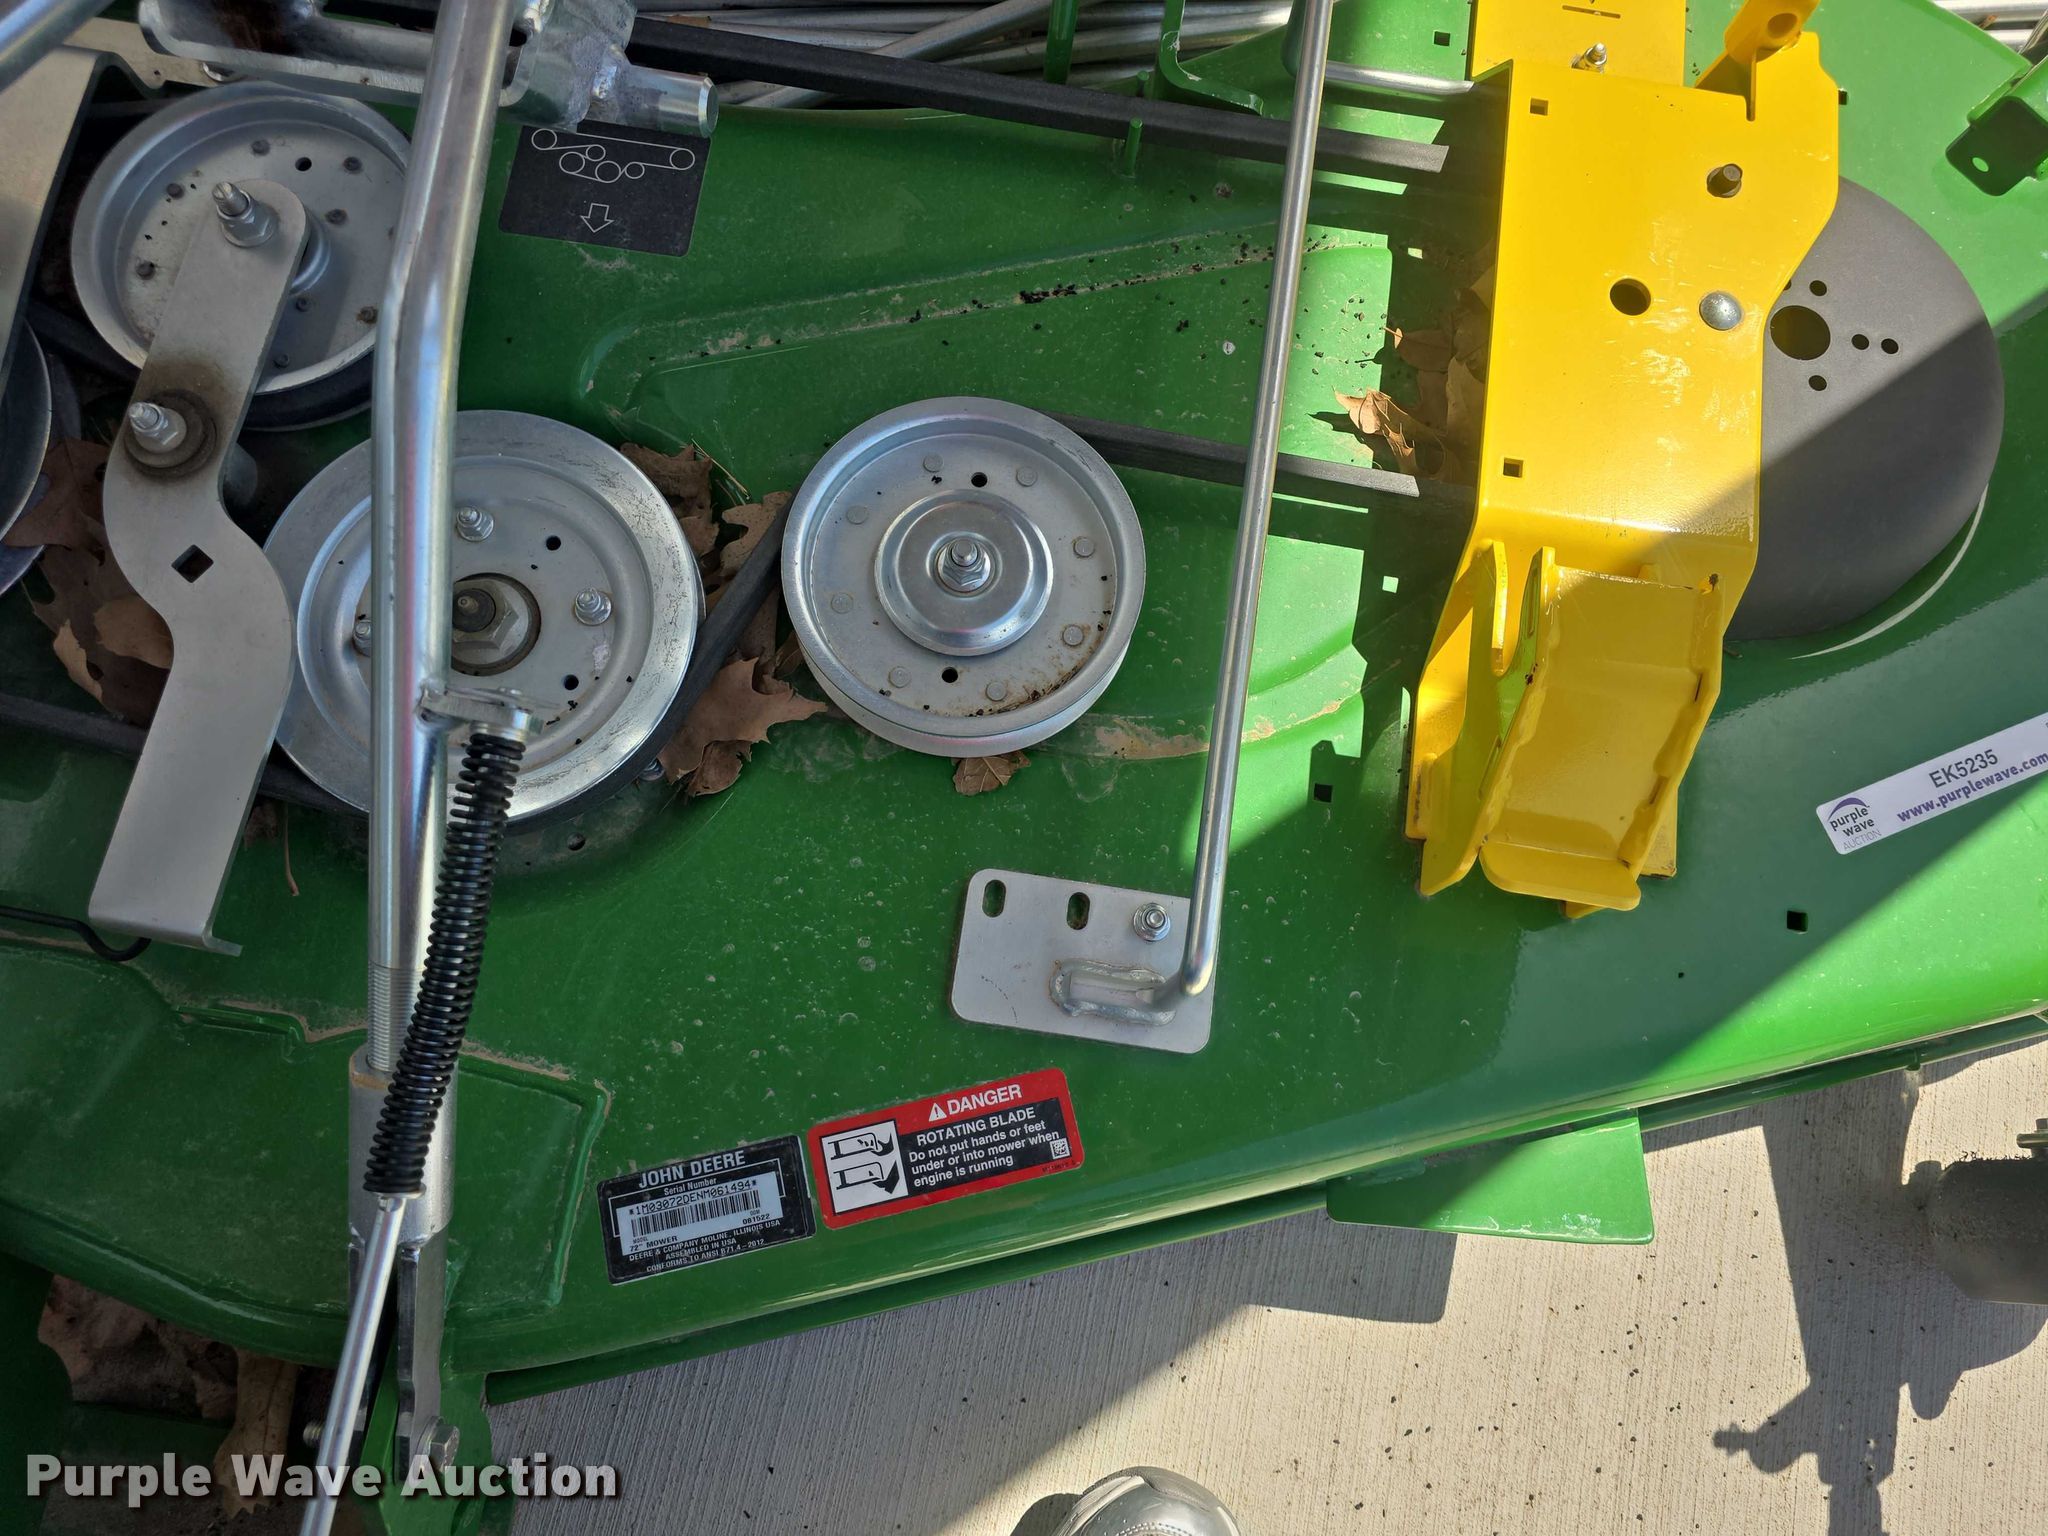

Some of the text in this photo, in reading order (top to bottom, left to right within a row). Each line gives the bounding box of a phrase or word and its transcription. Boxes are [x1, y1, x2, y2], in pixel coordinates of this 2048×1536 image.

[1929, 749, 1998, 788] EK5235
[1897, 752, 2048, 822] www.purplewave.com
[1829, 806, 1870, 831] purple
[1843, 817, 1875, 837] wave
[1843, 829, 1882, 851] AUCTION
[947, 1084, 1022, 1115] DANGER
[909, 1119, 1046, 1163] Do not put hands or feet
[917, 1107, 1036, 1146] ROTATING BLADE
[911, 1129, 1060, 1176] under or into mower when
[639, 1150, 745, 1188] JOHN DEERE
[914, 1155, 1014, 1188] engine is running
[664, 1178, 716, 1196] Serial Number
[742, 1214, 770, 1224] 081522
[629, 1249, 653, 1261] DEERE
[663, 1239, 699, 1253] COMPANY
[733, 1223, 763, 1236] ILLINOIS
[765, 1219, 780, 1228] USA
[646, 1236, 678, 1248] MOWER
[665, 1237, 737, 1260] ASSEMBLED IN USA
[646, 1258, 688, 1272] CONFORMS
[689, 1255, 699, 1264] TO
[701, 1249, 719, 1259] ANSI
